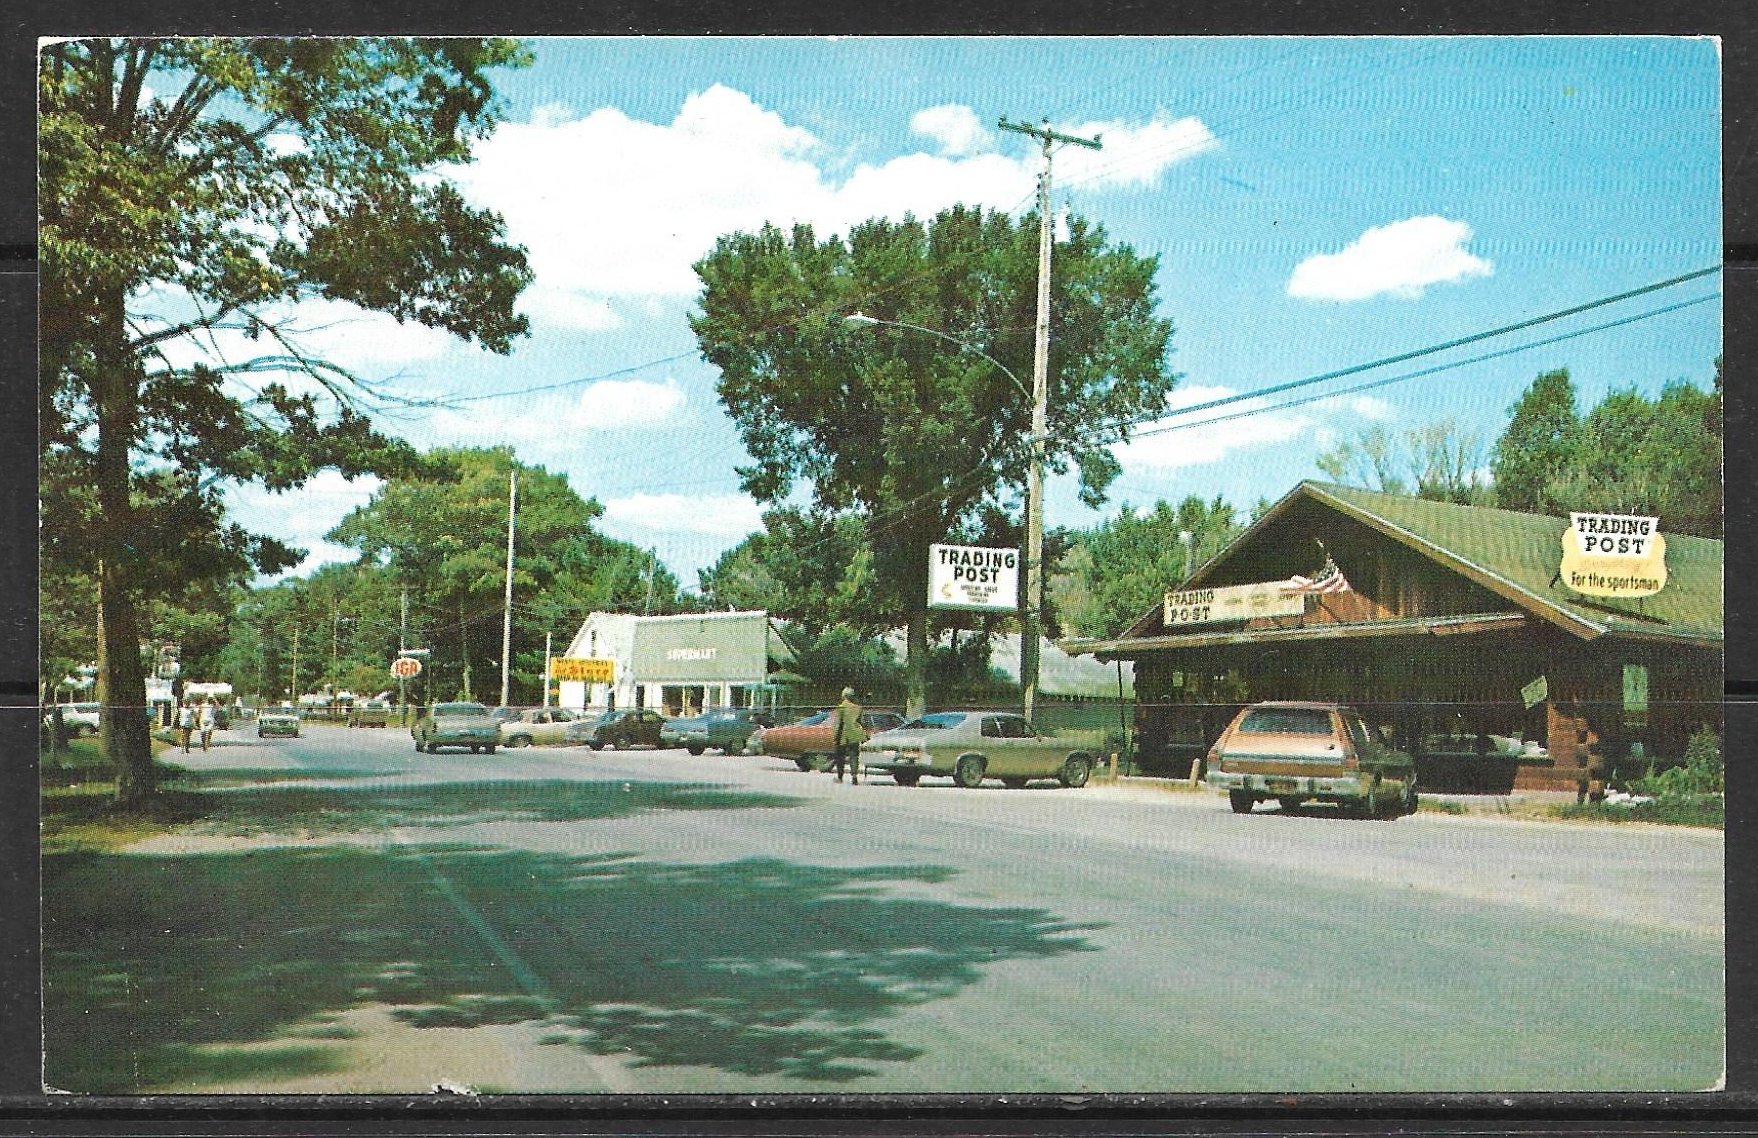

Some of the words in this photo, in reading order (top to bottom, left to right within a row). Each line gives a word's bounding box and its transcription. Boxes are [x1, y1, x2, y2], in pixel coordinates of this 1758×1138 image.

[1577, 516, 1650, 536] TRADING
[1584, 535, 1645, 555] POST
[938, 548, 1015, 569] TRADING
[953, 565, 999, 584] POST
[1571, 571, 1587, 588] For
[1589, 572, 1606, 588] the
[1607, 575, 1660, 592] sportsman
[1167, 590, 1214, 607] TRADING
[1170, 605, 1210, 623] POST
